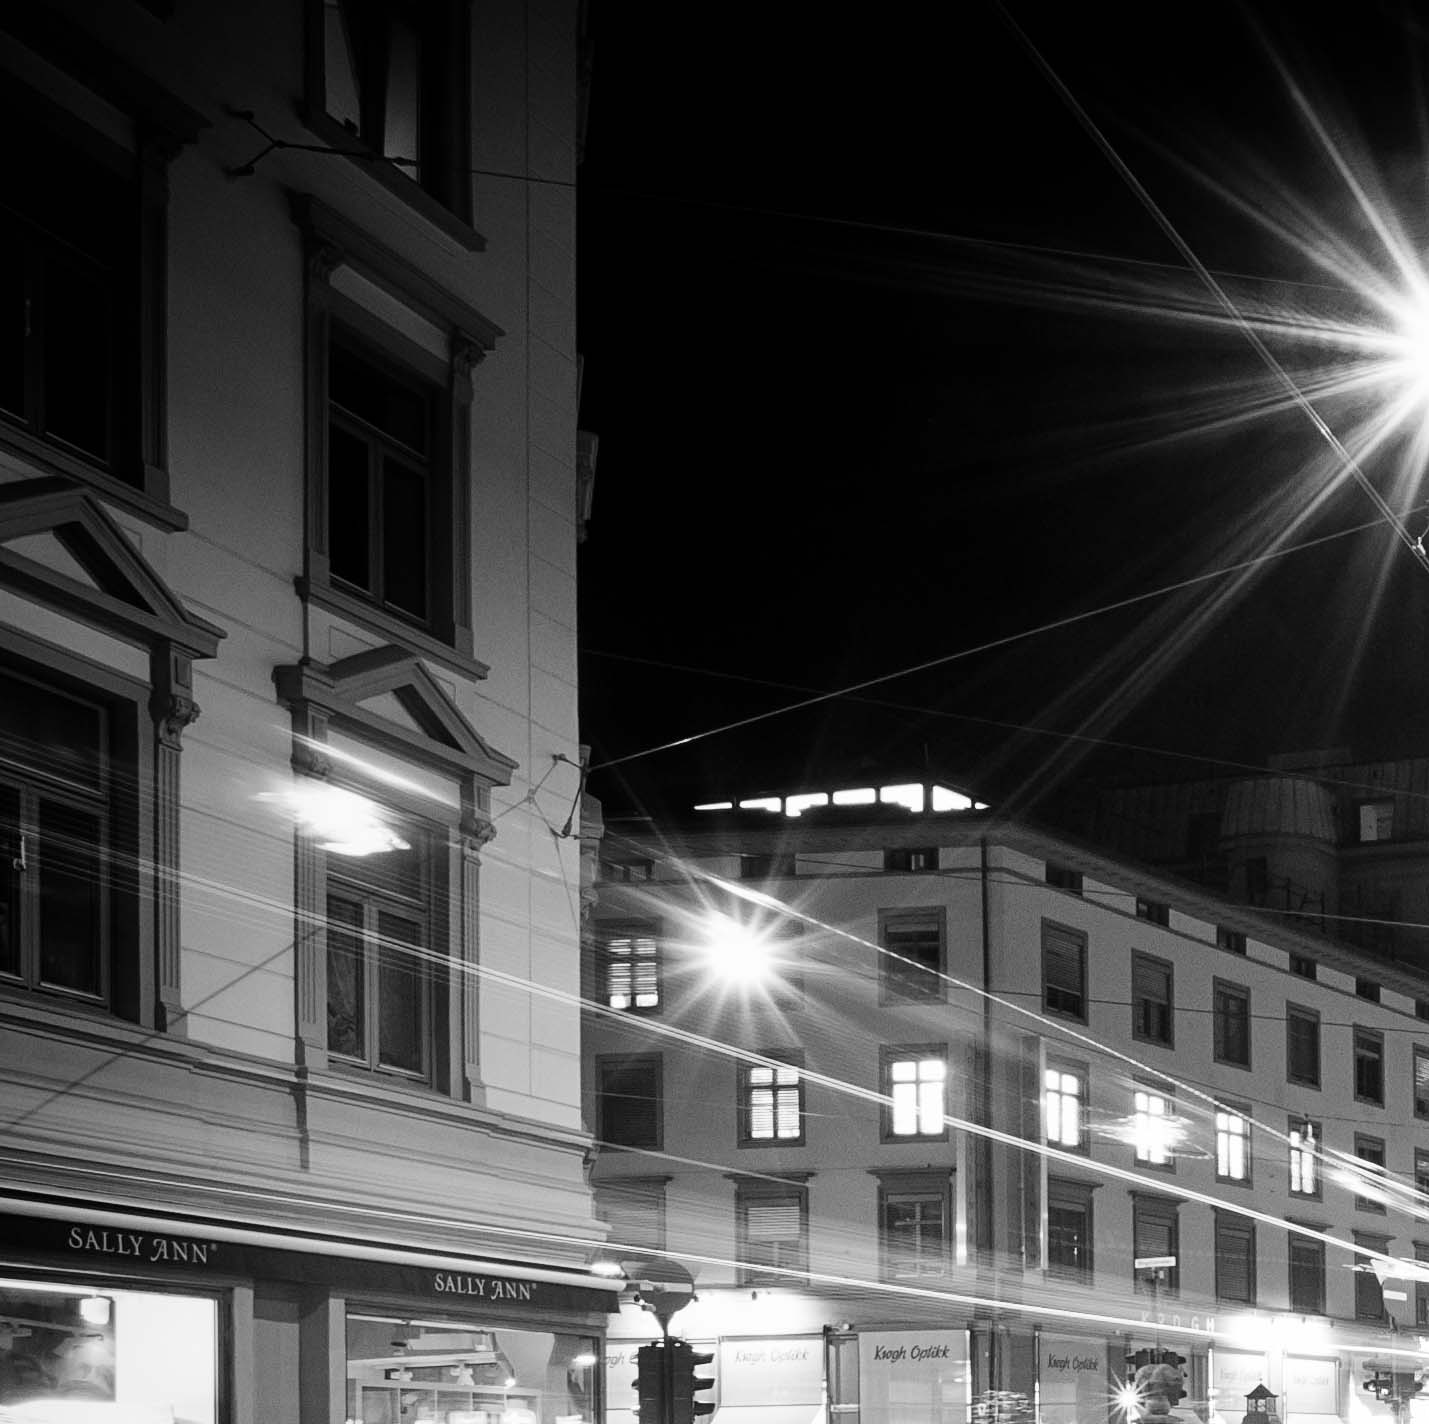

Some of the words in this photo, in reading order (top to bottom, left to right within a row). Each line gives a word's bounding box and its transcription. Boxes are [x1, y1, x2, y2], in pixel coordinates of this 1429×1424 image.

[68, 1227, 144, 1256] SALLY
[150, 1238, 208, 1264] ANN
[434, 1273, 485, 1296] SALLY
[490, 1280, 531, 1300] ANN
[874, 1345, 906, 1363] Krogh
[910, 1345, 950, 1362] Optikk
